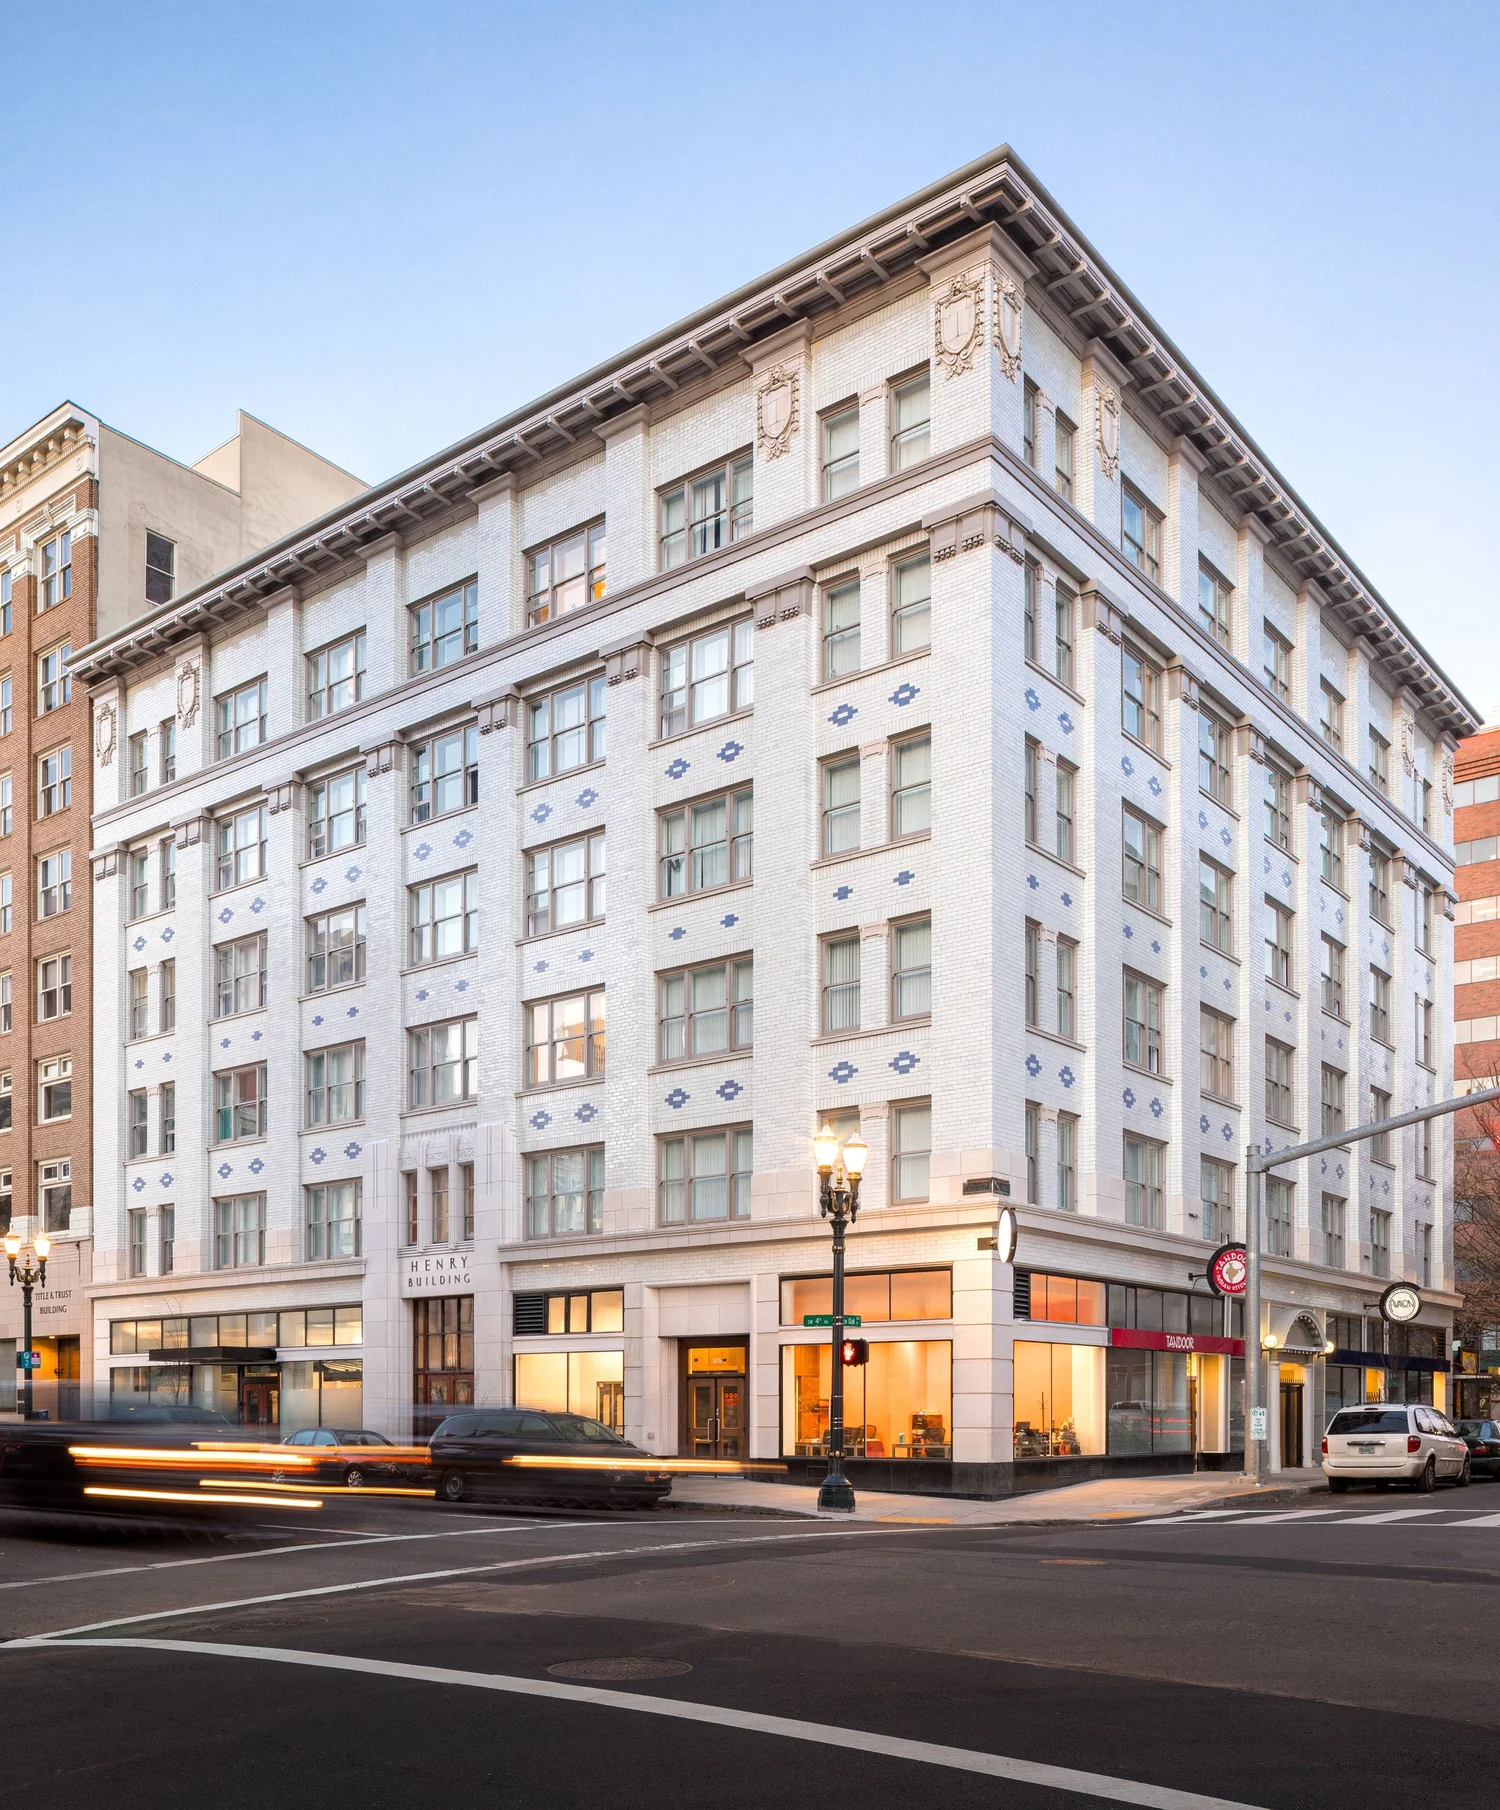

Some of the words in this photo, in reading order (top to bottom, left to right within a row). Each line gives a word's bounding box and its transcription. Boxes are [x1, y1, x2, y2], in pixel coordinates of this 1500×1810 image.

[411, 1256, 467, 1272] HENRY
[1216, 1253, 1246, 1270] TANDOO
[408, 1273, 470, 1287] BUILDING
[1216, 1275, 1231, 1290] INDIAN
[1232, 1280, 1246, 1291] KITCH
[35, 1292, 49, 1300] TITLE
[50, 1291, 54, 1299] &
[55, 1290, 72, 1299] TRUST
[40, 1305, 67, 1314] BUILDING
[1166, 1335, 1194, 1349] TANDOOR
